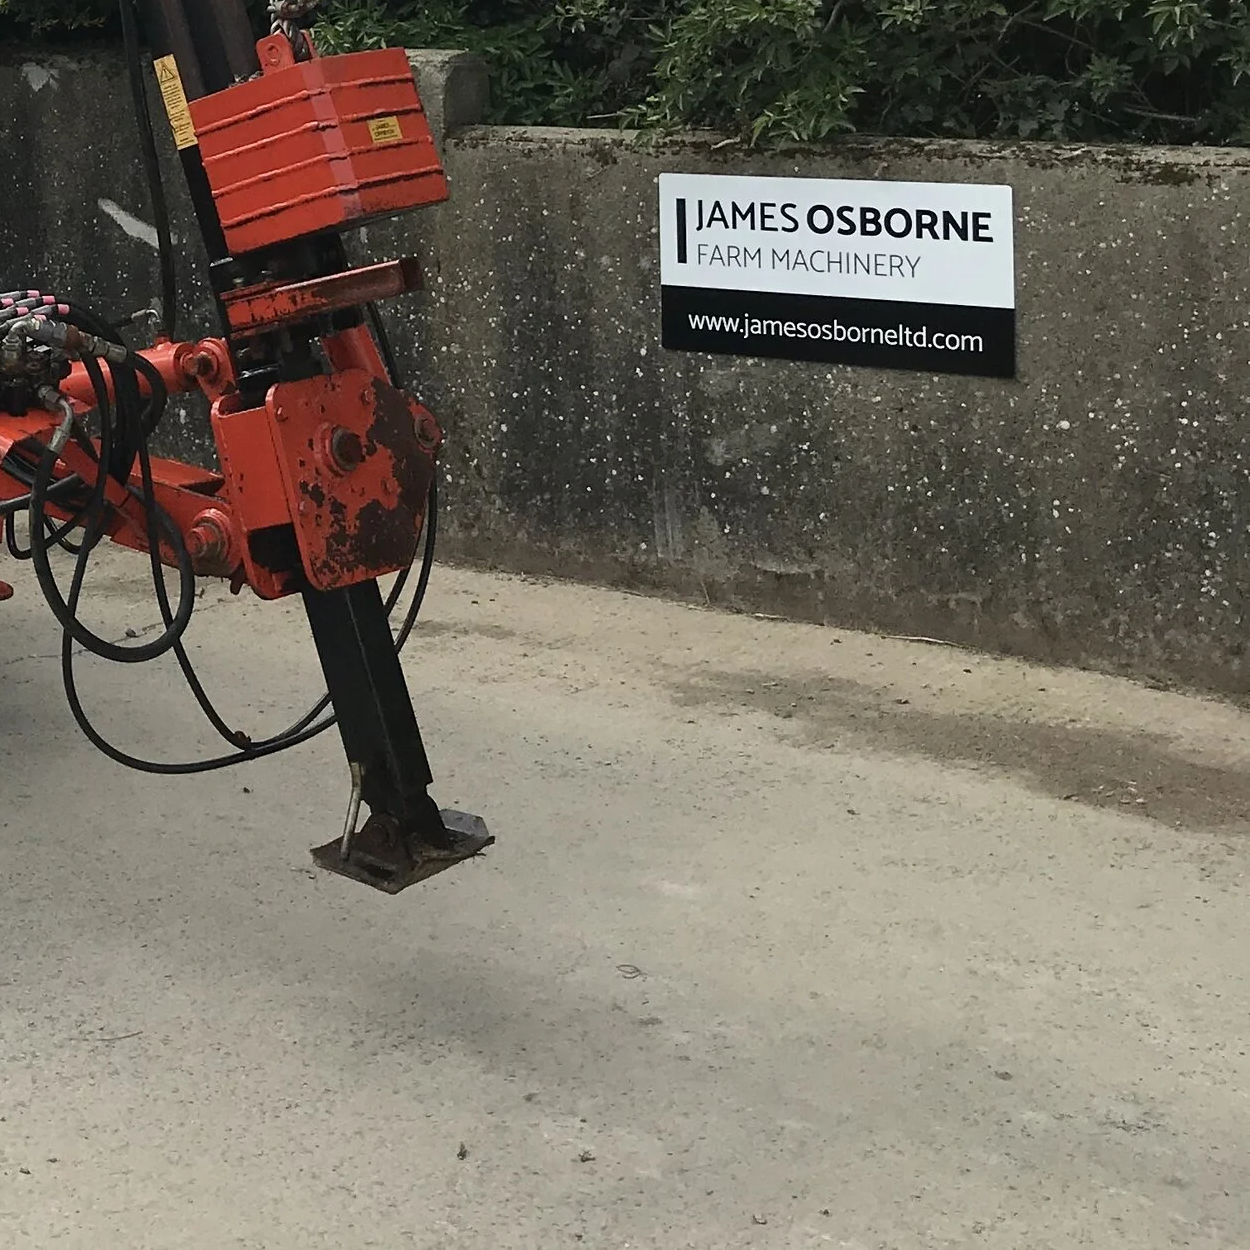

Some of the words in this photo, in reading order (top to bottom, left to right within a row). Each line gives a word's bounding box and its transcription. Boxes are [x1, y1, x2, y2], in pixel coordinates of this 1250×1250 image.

[696, 199, 799, 233] JAMES
[806, 204, 994, 243] OSBORNE
[697, 244, 762, 269] FARM
[771, 248, 921, 279] MACHINERY
[688, 312, 983, 353] www.jamesosborneltd.com
